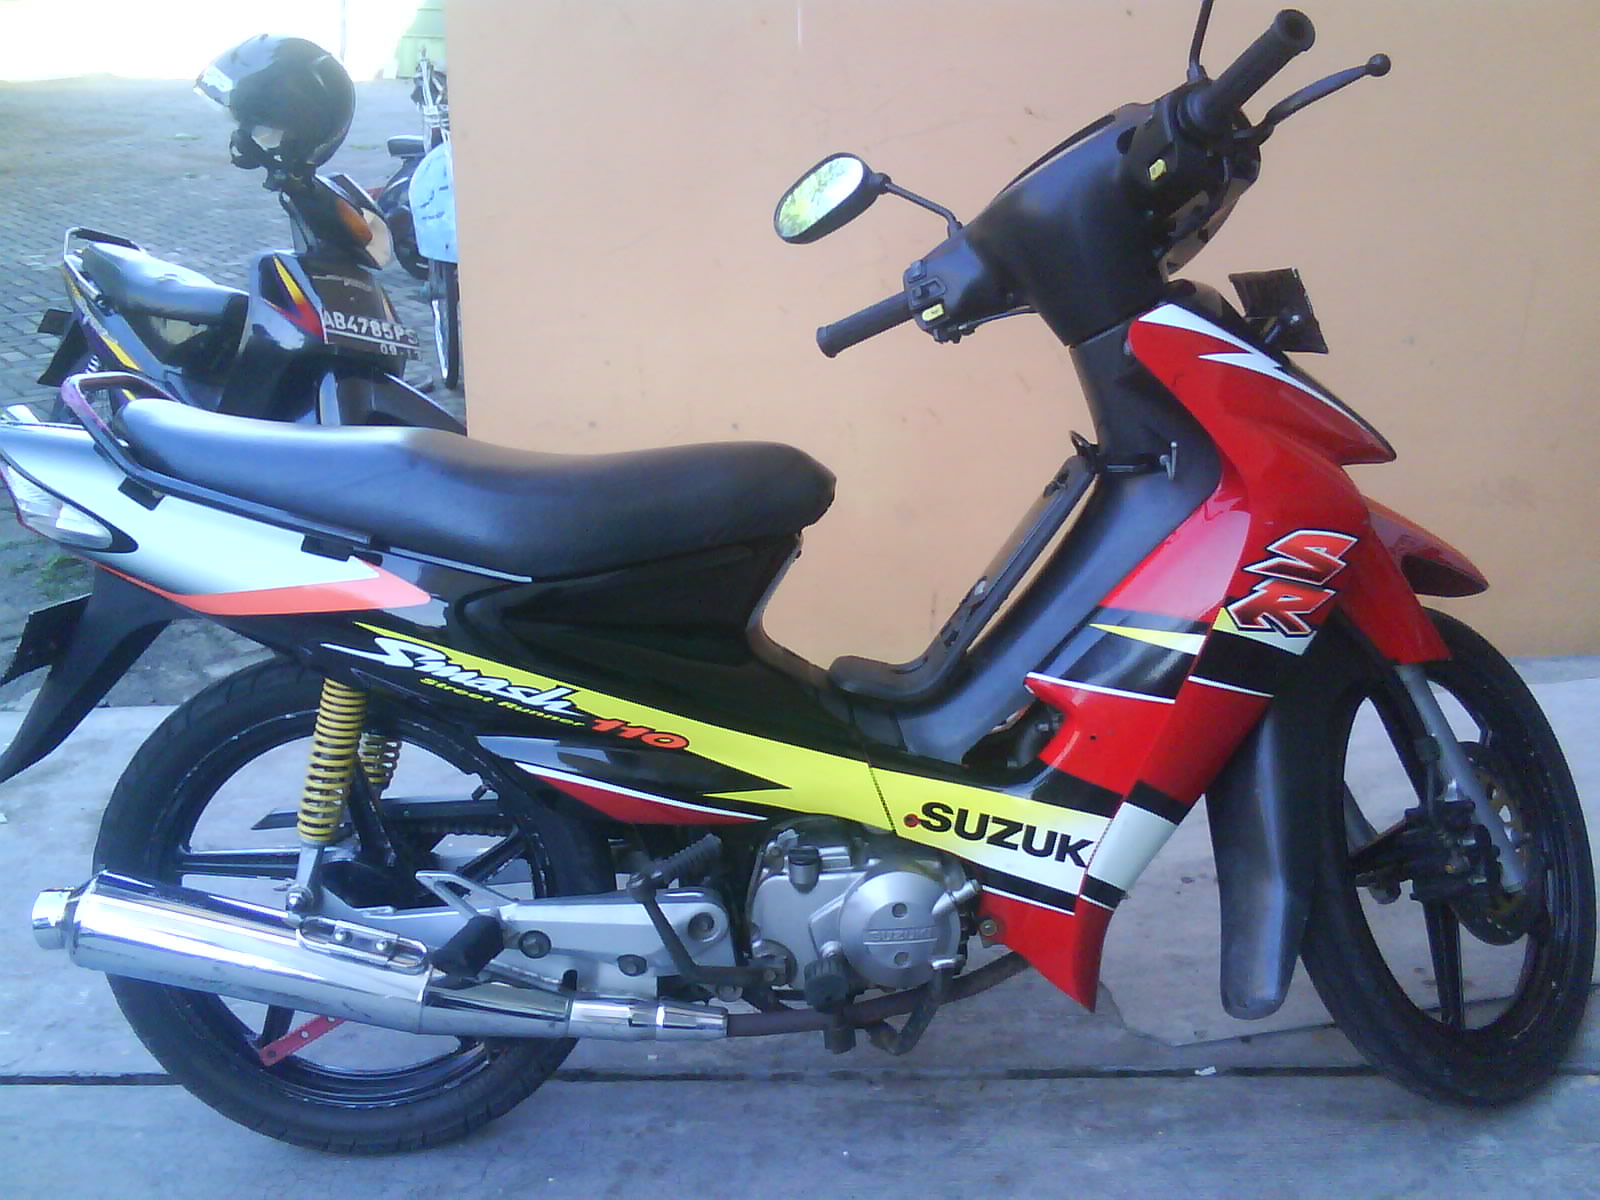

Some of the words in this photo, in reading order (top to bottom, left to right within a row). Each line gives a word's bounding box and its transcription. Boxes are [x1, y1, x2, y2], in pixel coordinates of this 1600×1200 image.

[320, 637, 585, 717] Smash
[591, 718, 689, 750] 110
[918, 801, 1094, 868] SUZUK
